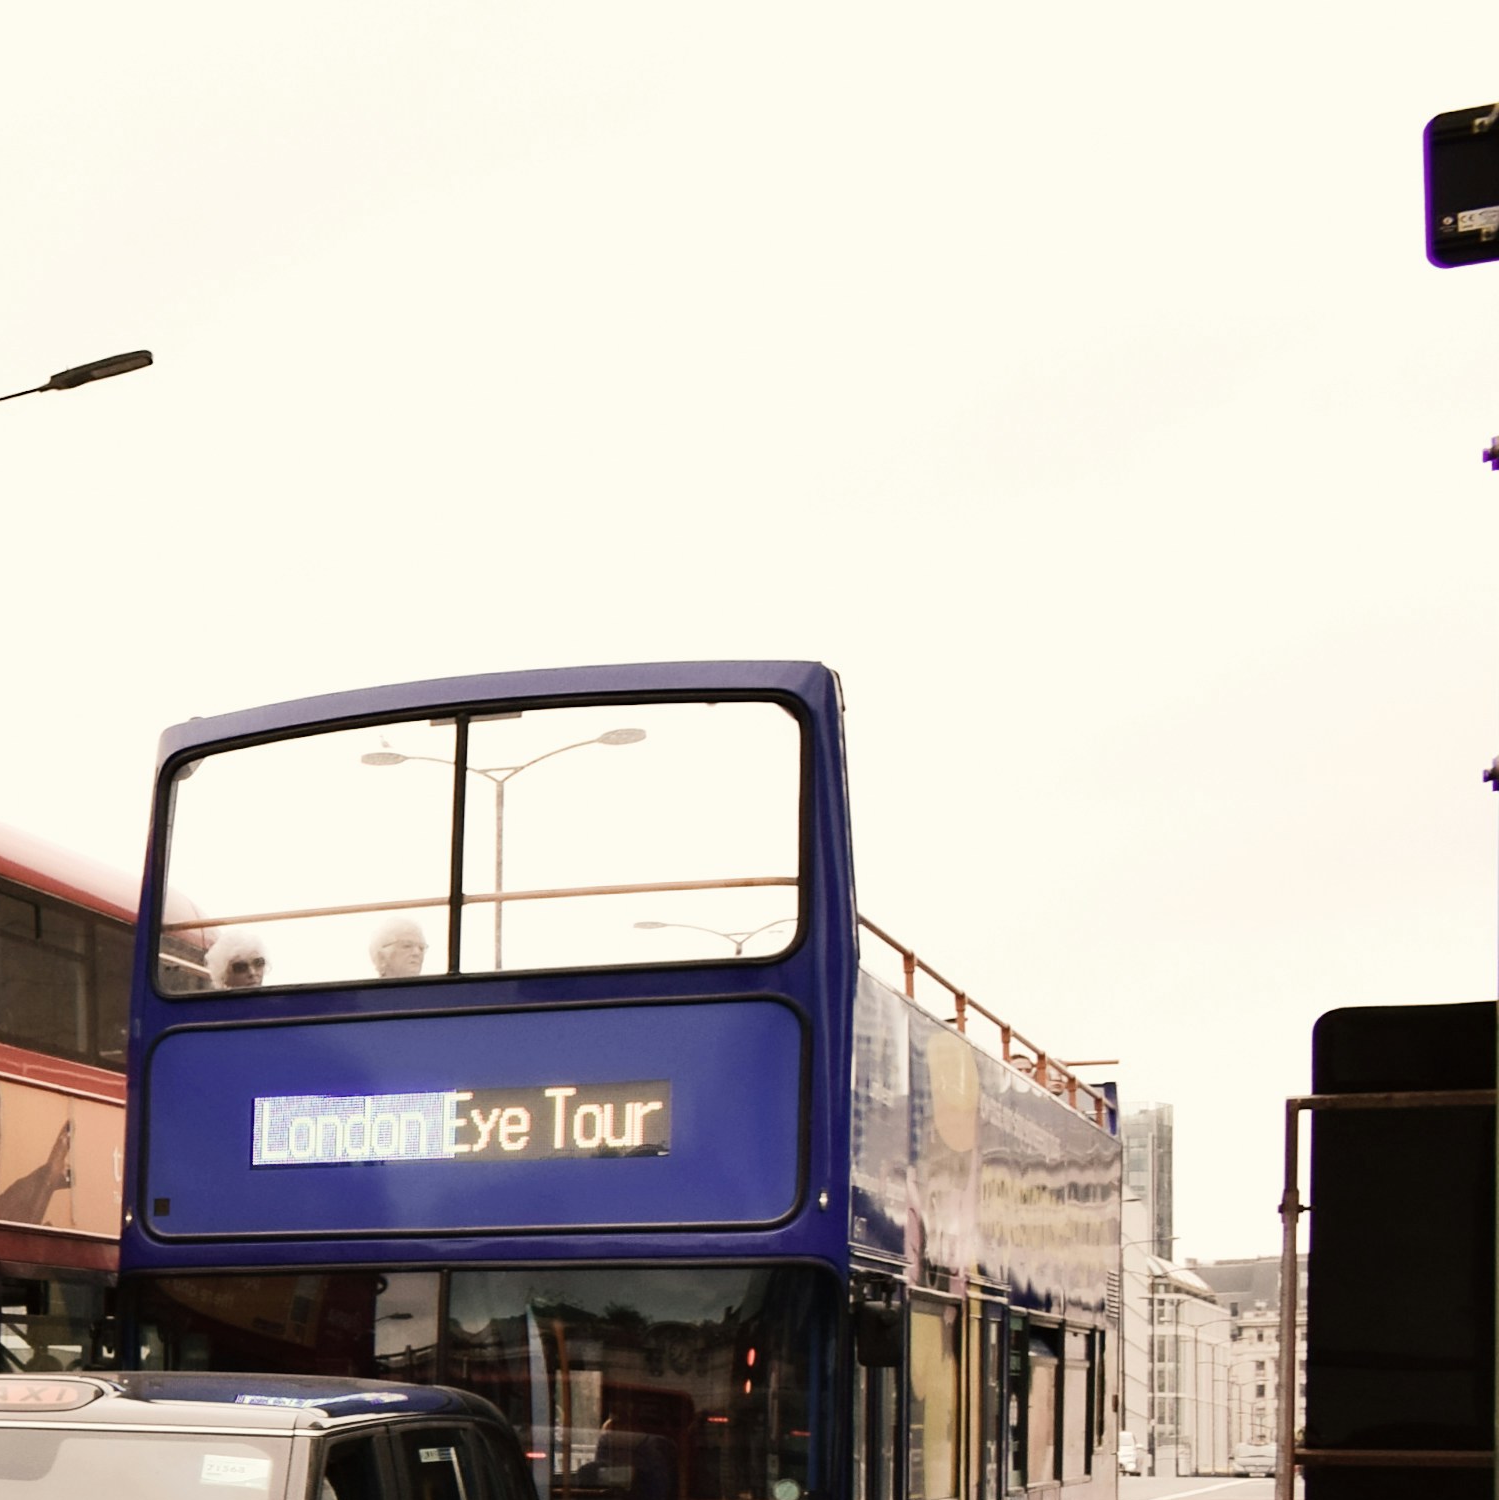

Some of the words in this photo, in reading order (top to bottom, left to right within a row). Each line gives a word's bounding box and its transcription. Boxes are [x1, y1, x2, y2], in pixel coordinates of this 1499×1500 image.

[261, 1096, 425, 1161] London
[443, 1091, 531, 1153] Eye
[545, 1086, 663, 1149] Tour
